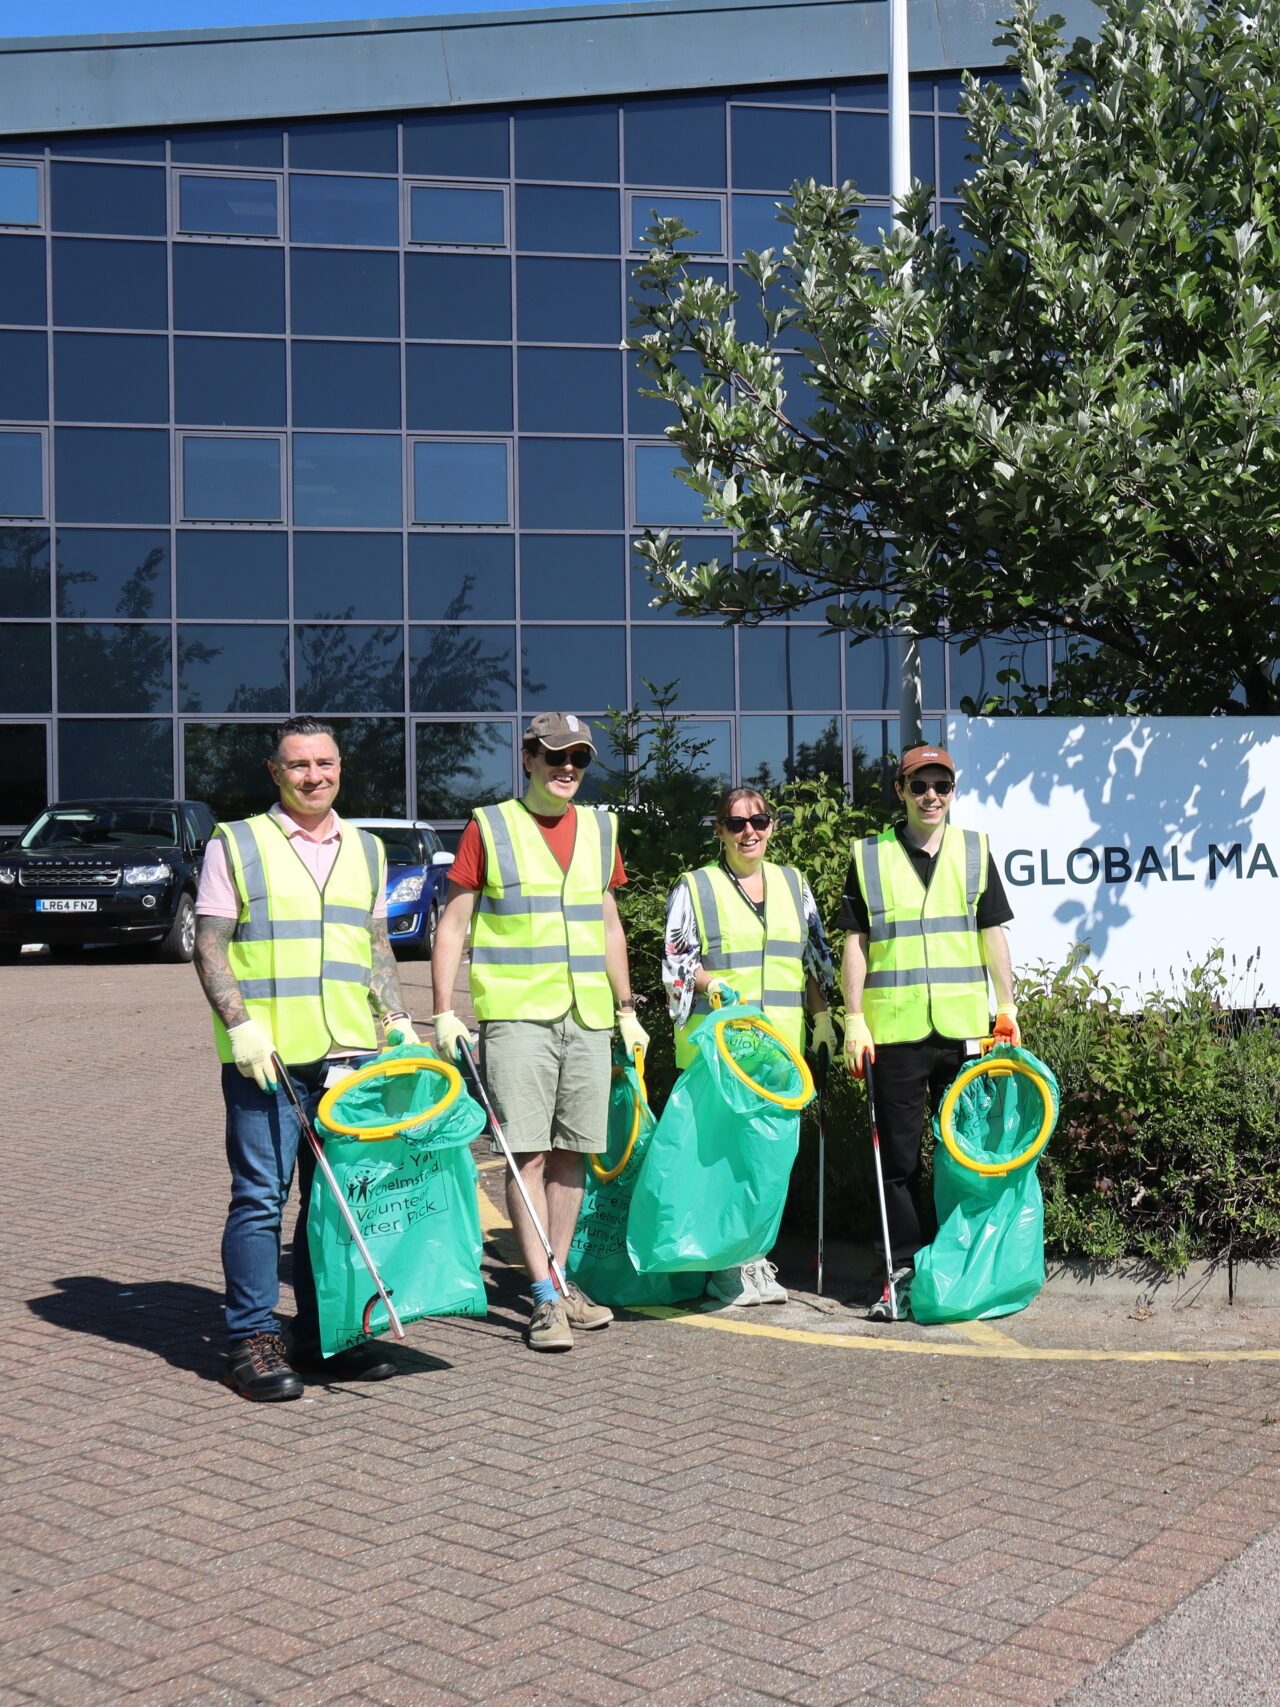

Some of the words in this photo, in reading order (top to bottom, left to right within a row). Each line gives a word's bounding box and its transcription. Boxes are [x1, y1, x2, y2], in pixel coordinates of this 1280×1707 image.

[1004, 845, 1195, 886] GLOBAL
[42, 900, 70, 911] LR64
[73, 900, 95, 911] FNZ
[406, 1199, 437, 1226] Pick
